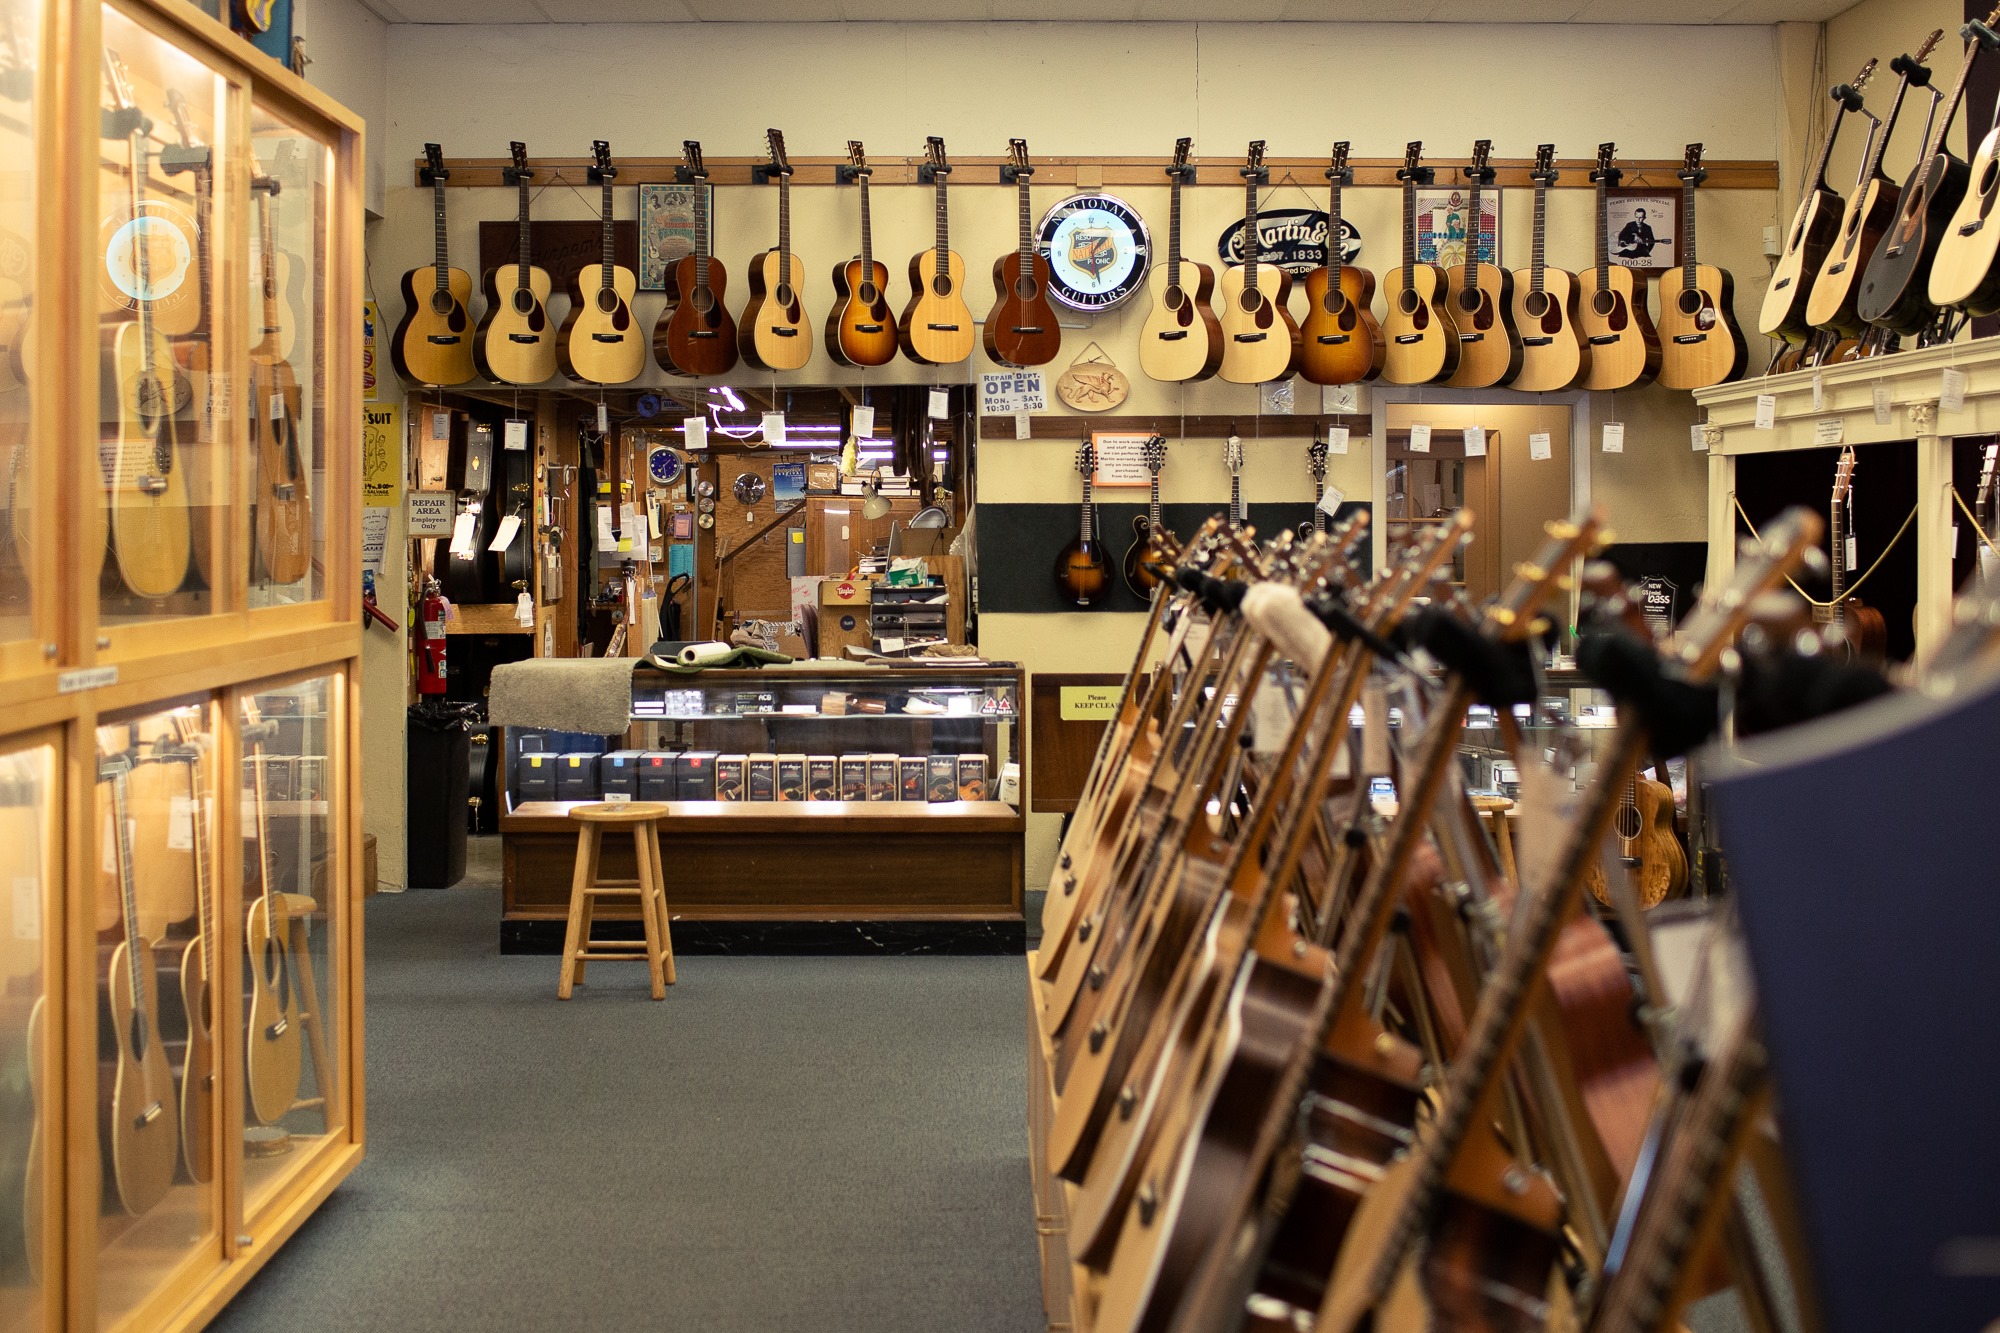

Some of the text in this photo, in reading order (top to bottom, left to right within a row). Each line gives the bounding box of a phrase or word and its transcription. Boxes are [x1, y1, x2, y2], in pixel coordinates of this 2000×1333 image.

[1052, 199, 1126, 226] NATIONAL
[1293, 250, 1322, 260] 1833
[1622, 259, 1652, 267] 000-28
[1061, 285, 1127, 305] GUITARS
[985, 379, 1040, 395] OPEN
[986, 404, 1010, 412] 10:30
[1023, 402, 1043, 410] 5:30
[368, 413, 392, 424] SUIT
[836, 587, 856, 596] Taylor
[1648, 592, 1670, 604] bass
